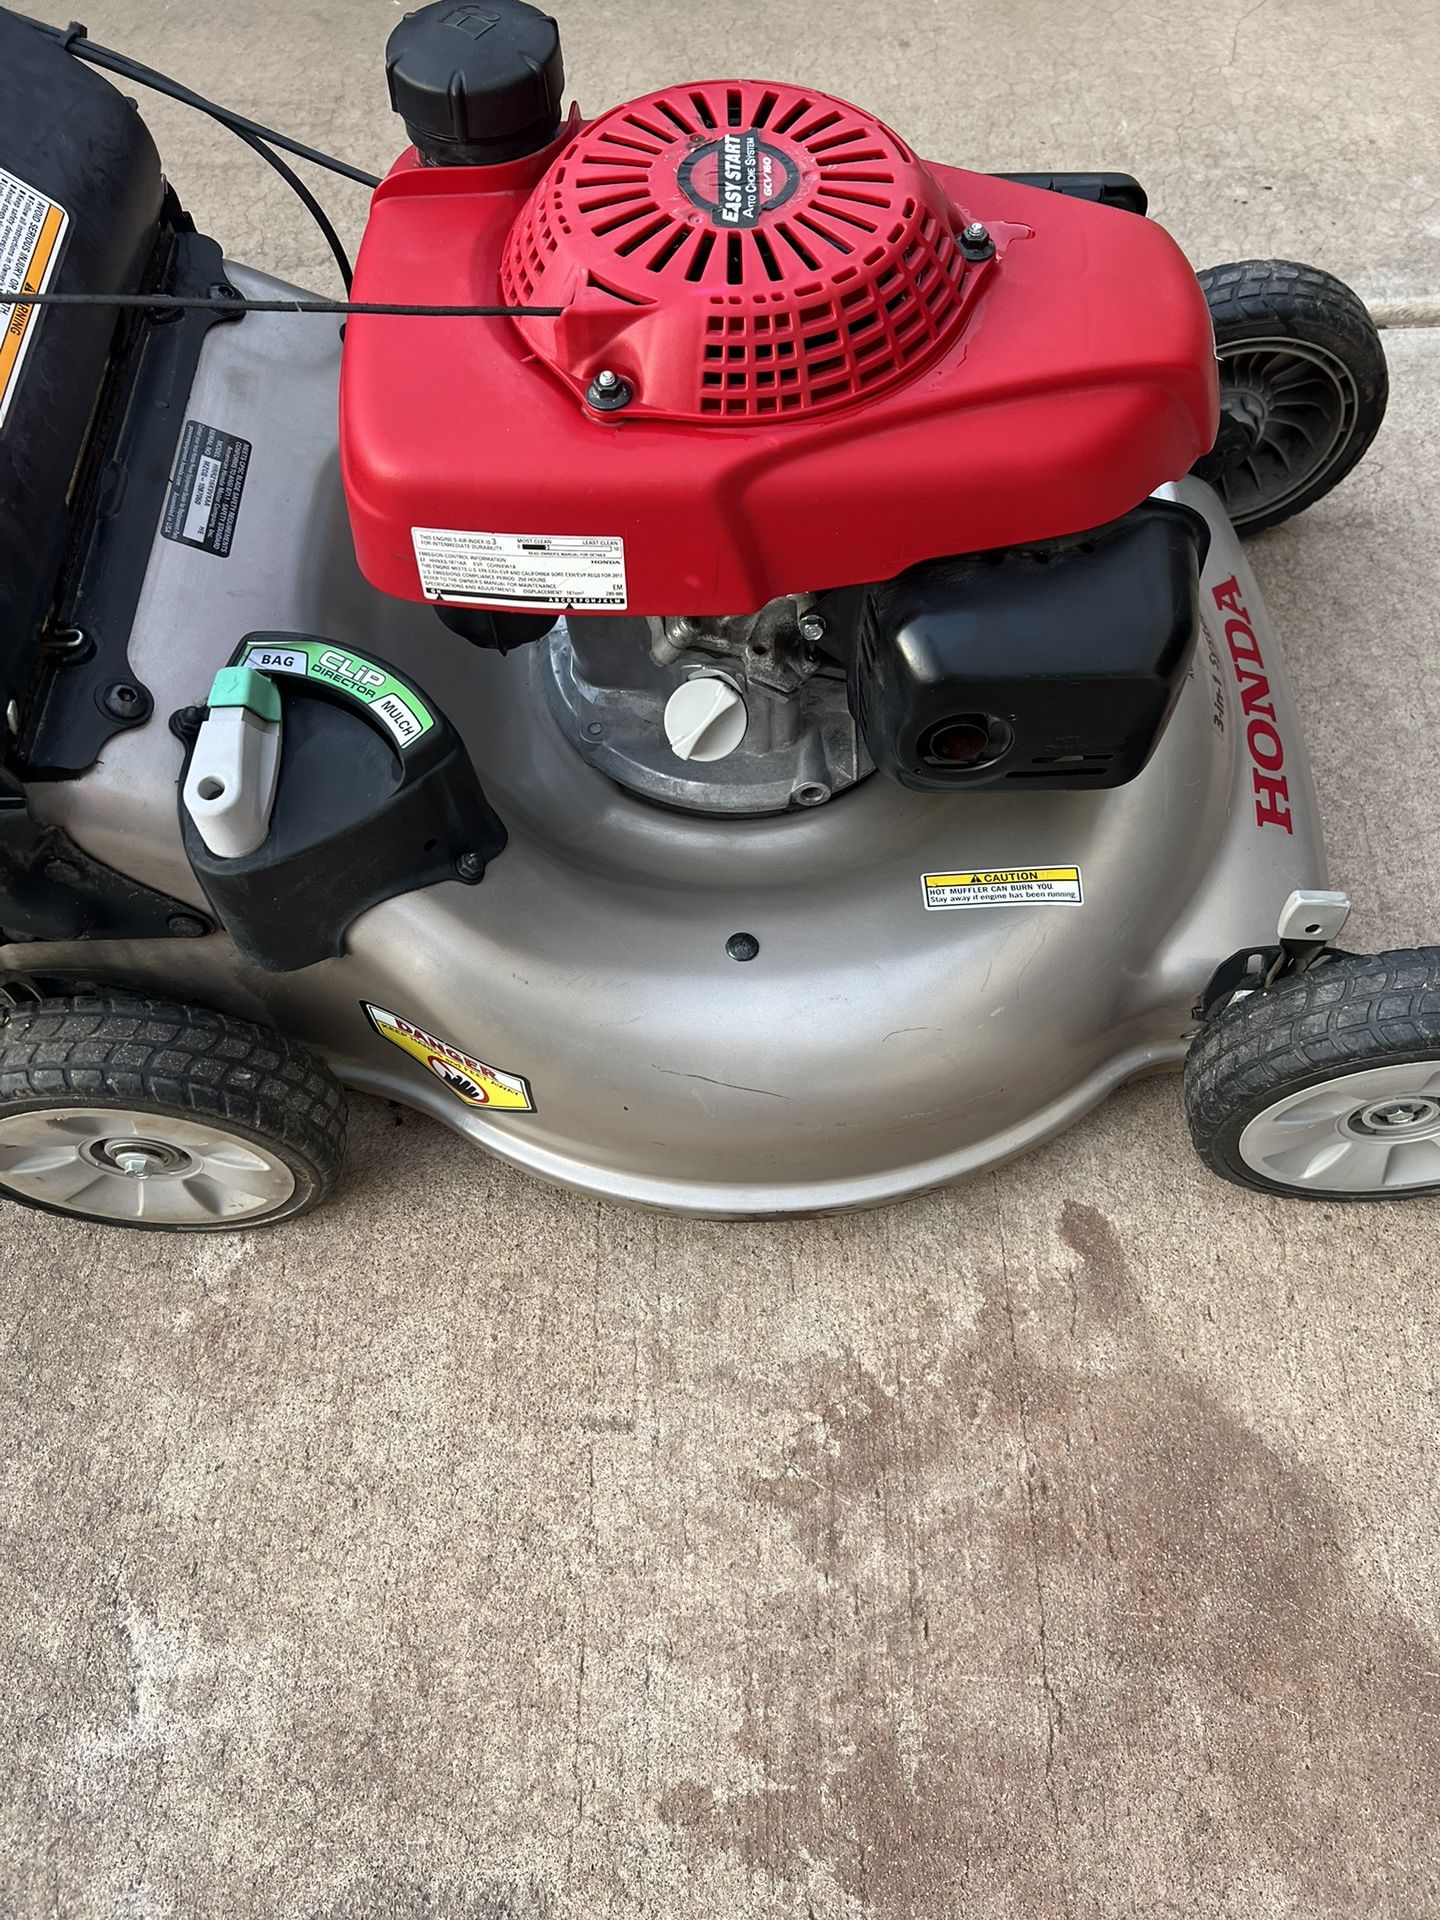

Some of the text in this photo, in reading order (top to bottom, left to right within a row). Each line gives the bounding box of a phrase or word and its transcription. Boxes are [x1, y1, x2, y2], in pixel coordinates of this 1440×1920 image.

[722, 134, 742, 222] EASY START
[763, 157, 773, 196] GCV160
[4, 186, 15, 205] Avoid
[12, 192, 24, 210] Keep
[6, 206, 18, 227] safety
[22, 198, 33, 218] Follow
[19, 215, 27, 226] all
[7, 223, 24, 259] instructions
[8, 200, 45, 291] AVOID SERIOUS INJURY OR
[5, 255, 13, 265] in
[10, 303, 30, 336] RNING
[206, 428, 214, 446] SERIAL
[214, 439, 222, 459] MODEL
[223, 446, 232, 469] American
[234, 474, 242, 491] BLADE
[230, 491, 238, 511] SAFETY
[219, 503, 228, 522] SAFETY
[213, 522, 223, 549] STANDARD
[220, 511, 234, 552] REQUIREMENTS
[425, 581, 464, 589] SPECIFICATIONS
[261, 655, 295, 667] BAG
[311, 664, 376, 698] DIRECTOR
[1212, 574, 1293, 835] HONDA
[381, 700, 415, 737] MULCH
[984, 872, 1038, 883] CAUTION
[930, 896, 948, 904] Stay
[980, 893, 1007, 902] engine
[950, 886, 988, 895] MUFFLER
[396, 1017, 498, 1081] DANGER
